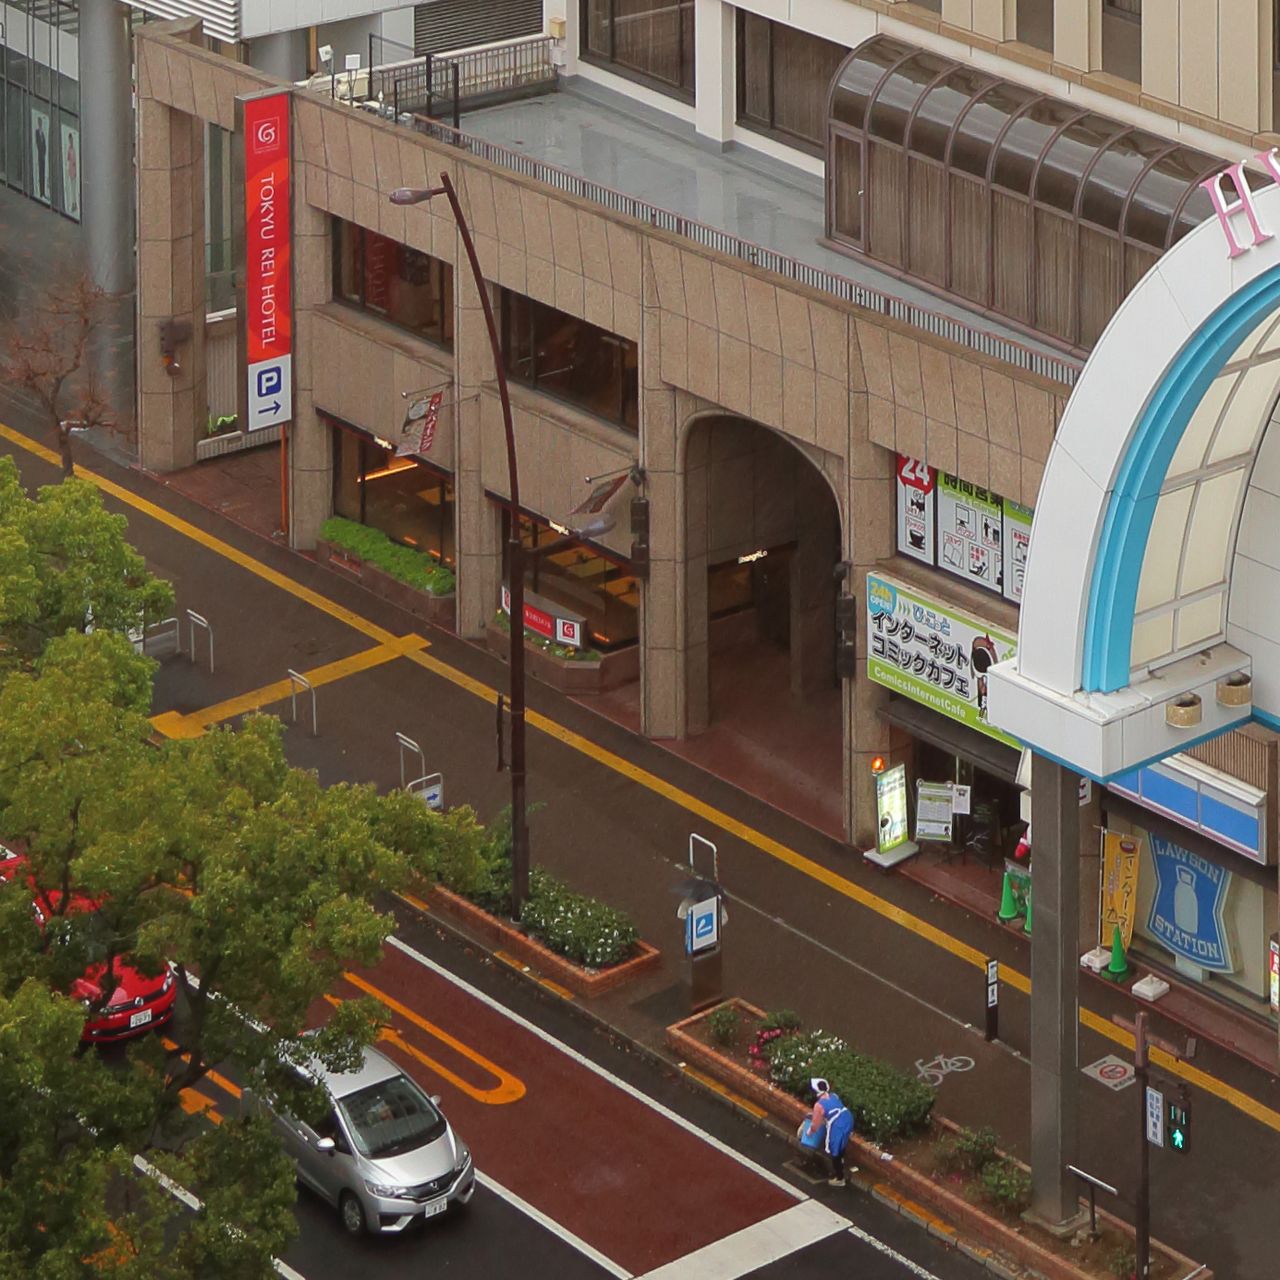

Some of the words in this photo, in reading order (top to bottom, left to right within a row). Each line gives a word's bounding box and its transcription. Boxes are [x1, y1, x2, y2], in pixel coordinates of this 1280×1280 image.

[260, 172, 275, 240] TOKYU
[260, 247, 276, 278] REI
[261, 284, 276, 350] HOTEL
[901, 456, 930, 486] 24
[871, 610, 970, 671] インターネット
[872, 631, 971, 699] コミックカフェ
[1155, 839, 1221, 884] LAWSON
[1153, 913, 1220, 959] STATION
